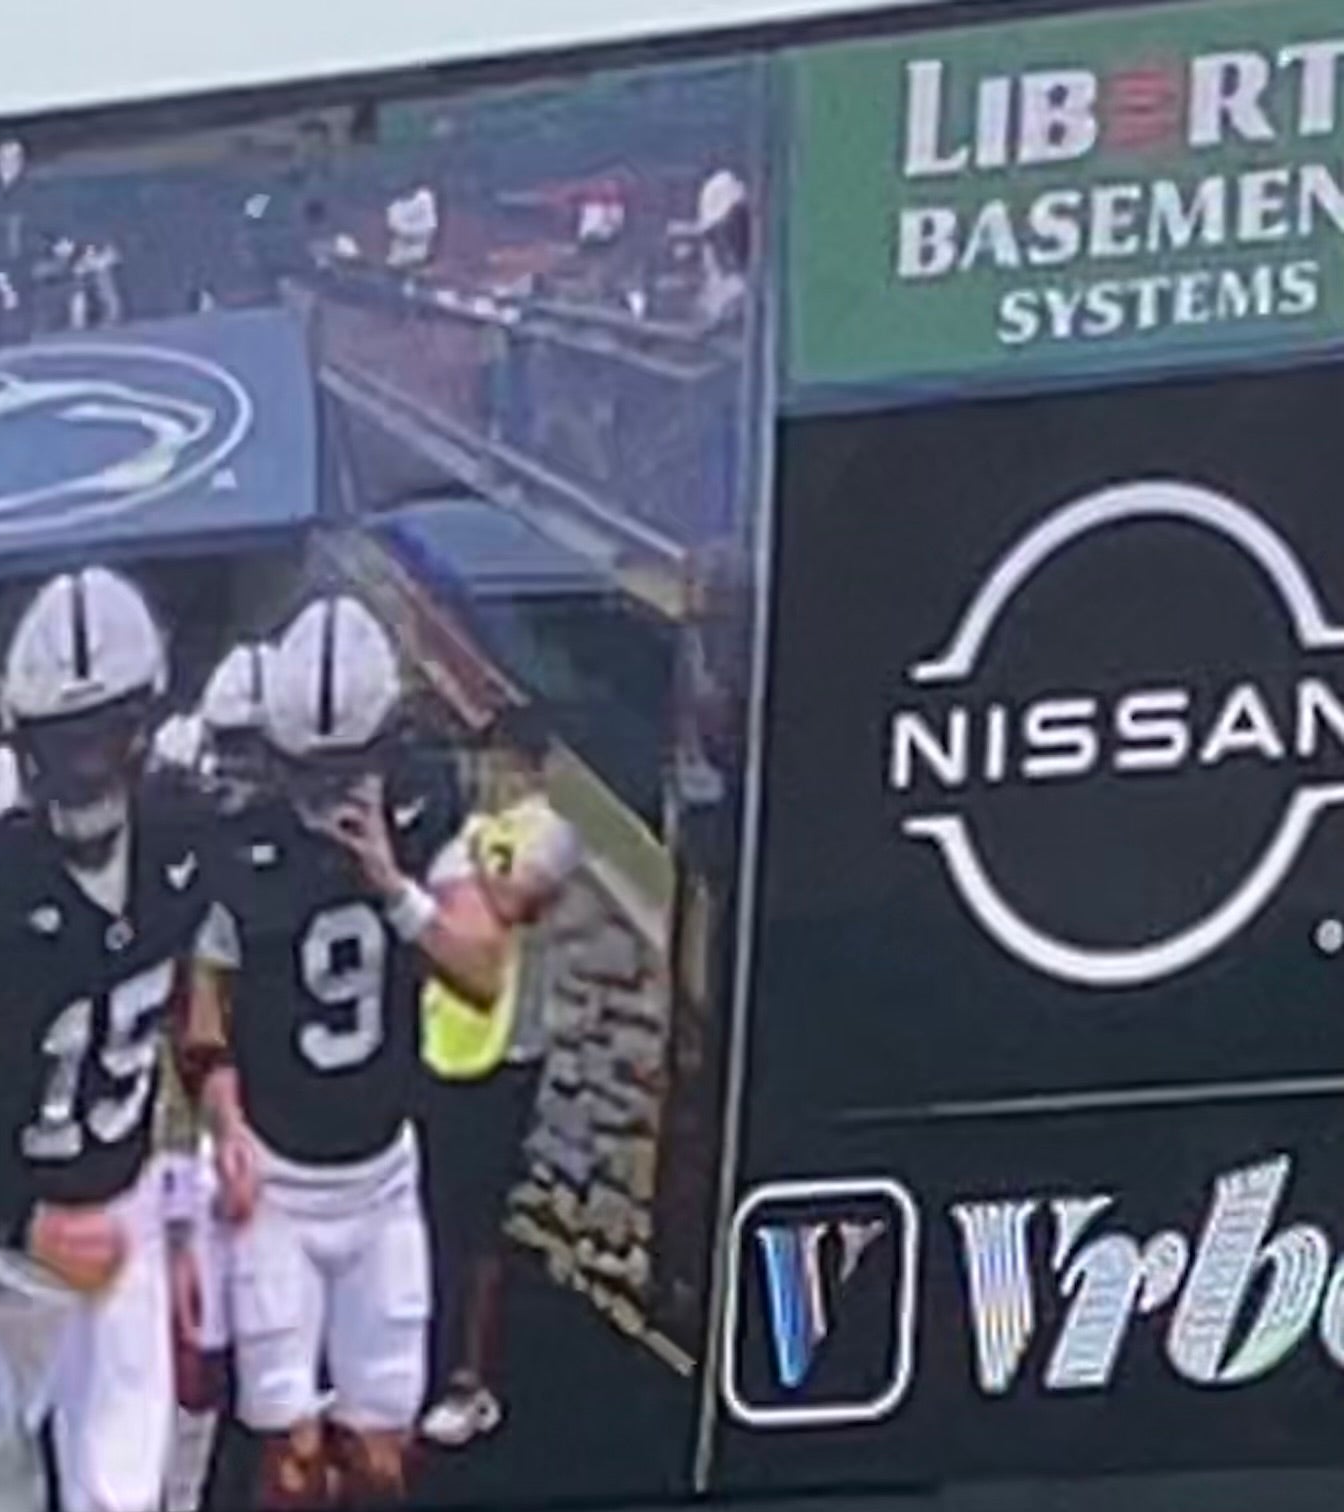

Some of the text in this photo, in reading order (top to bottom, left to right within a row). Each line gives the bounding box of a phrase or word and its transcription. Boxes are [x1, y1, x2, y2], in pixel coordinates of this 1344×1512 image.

[996, 260, 1321, 345] SYSTEMS
[891, 676, 1344, 788] NISSAN
[20, 957, 175, 1160] 15
[298, 902, 387, 1072] 9
[950, 1153, 1344, 1393] Vrb
